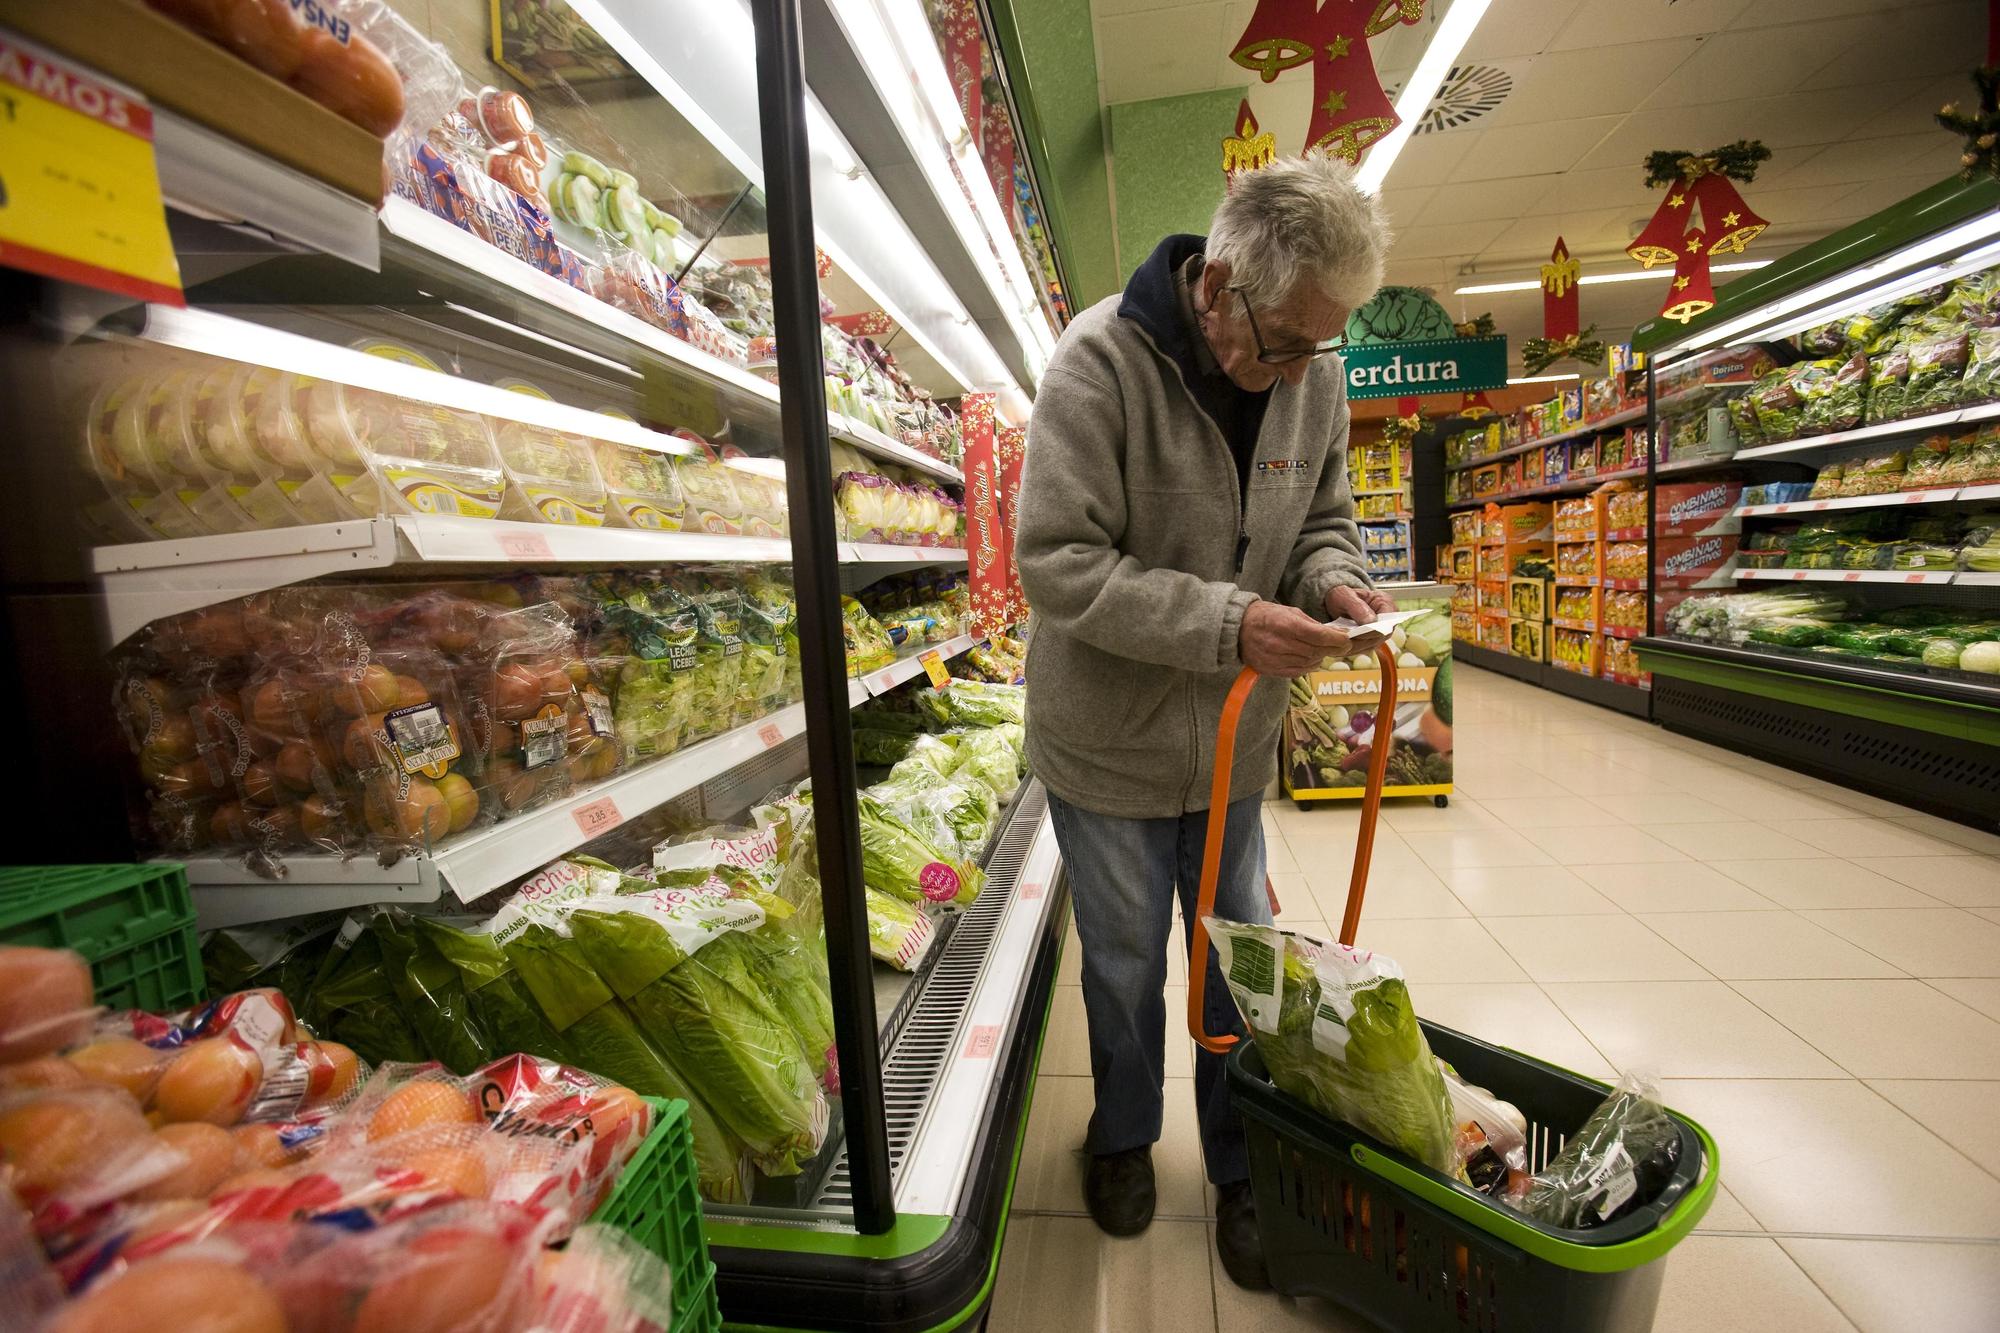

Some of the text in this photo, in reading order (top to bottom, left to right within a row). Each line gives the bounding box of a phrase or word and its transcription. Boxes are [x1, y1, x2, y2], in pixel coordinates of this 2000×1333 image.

[1340, 355, 1459, 388] erdura
[1711, 362, 1745, 376] Doritos
[1669, 484, 1728, 518] COMBINADO
[1665, 537, 1723, 571] COMBINADO
[209, 704, 251, 777] AGROMALLORCA
